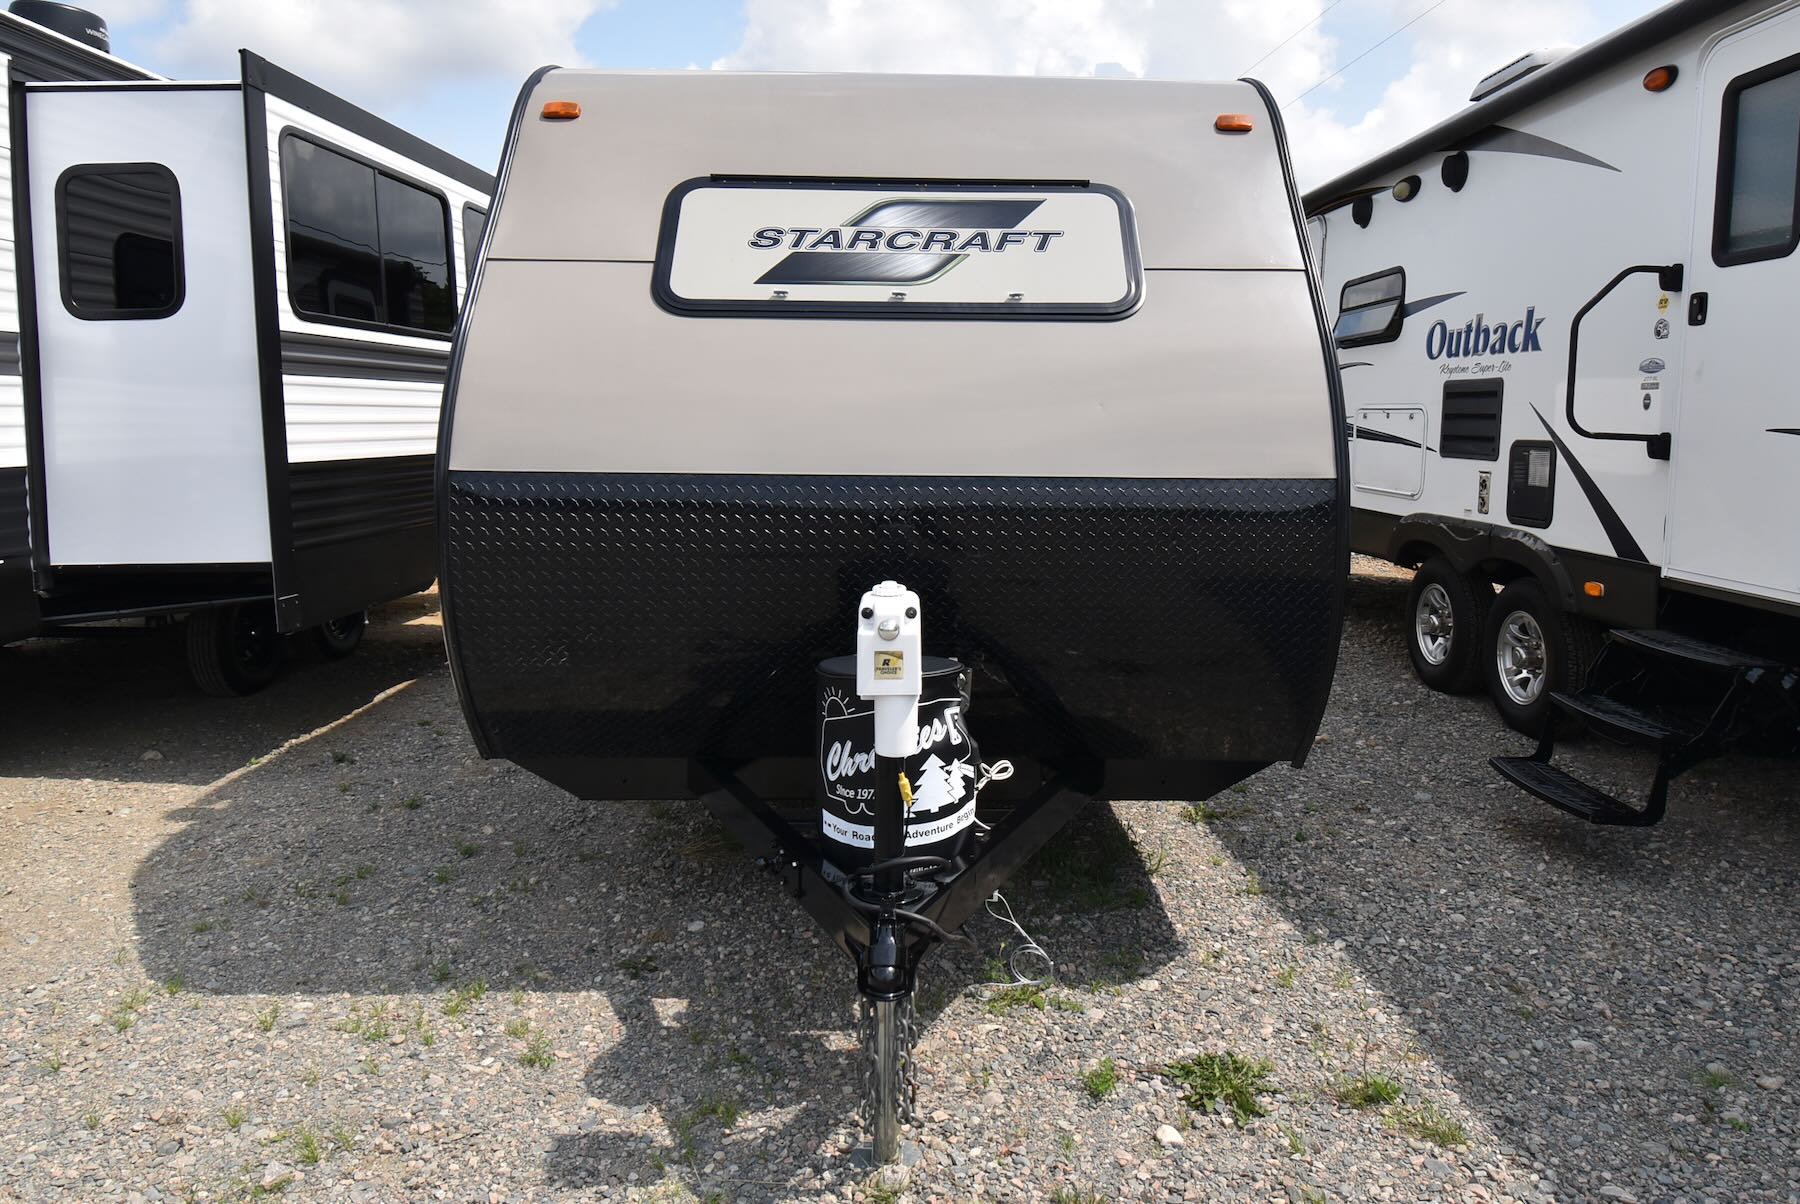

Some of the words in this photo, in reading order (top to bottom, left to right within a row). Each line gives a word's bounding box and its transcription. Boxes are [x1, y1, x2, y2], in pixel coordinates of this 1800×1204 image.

[747, 227, 1064, 253] STARCRAFT
[1426, 306, 1546, 360] Outback
[836, 784, 855, 798] Since
[856, 788, 875, 800] 197
[832, 824, 848, 837] Your
[905, 822, 954, 840] Adventure
